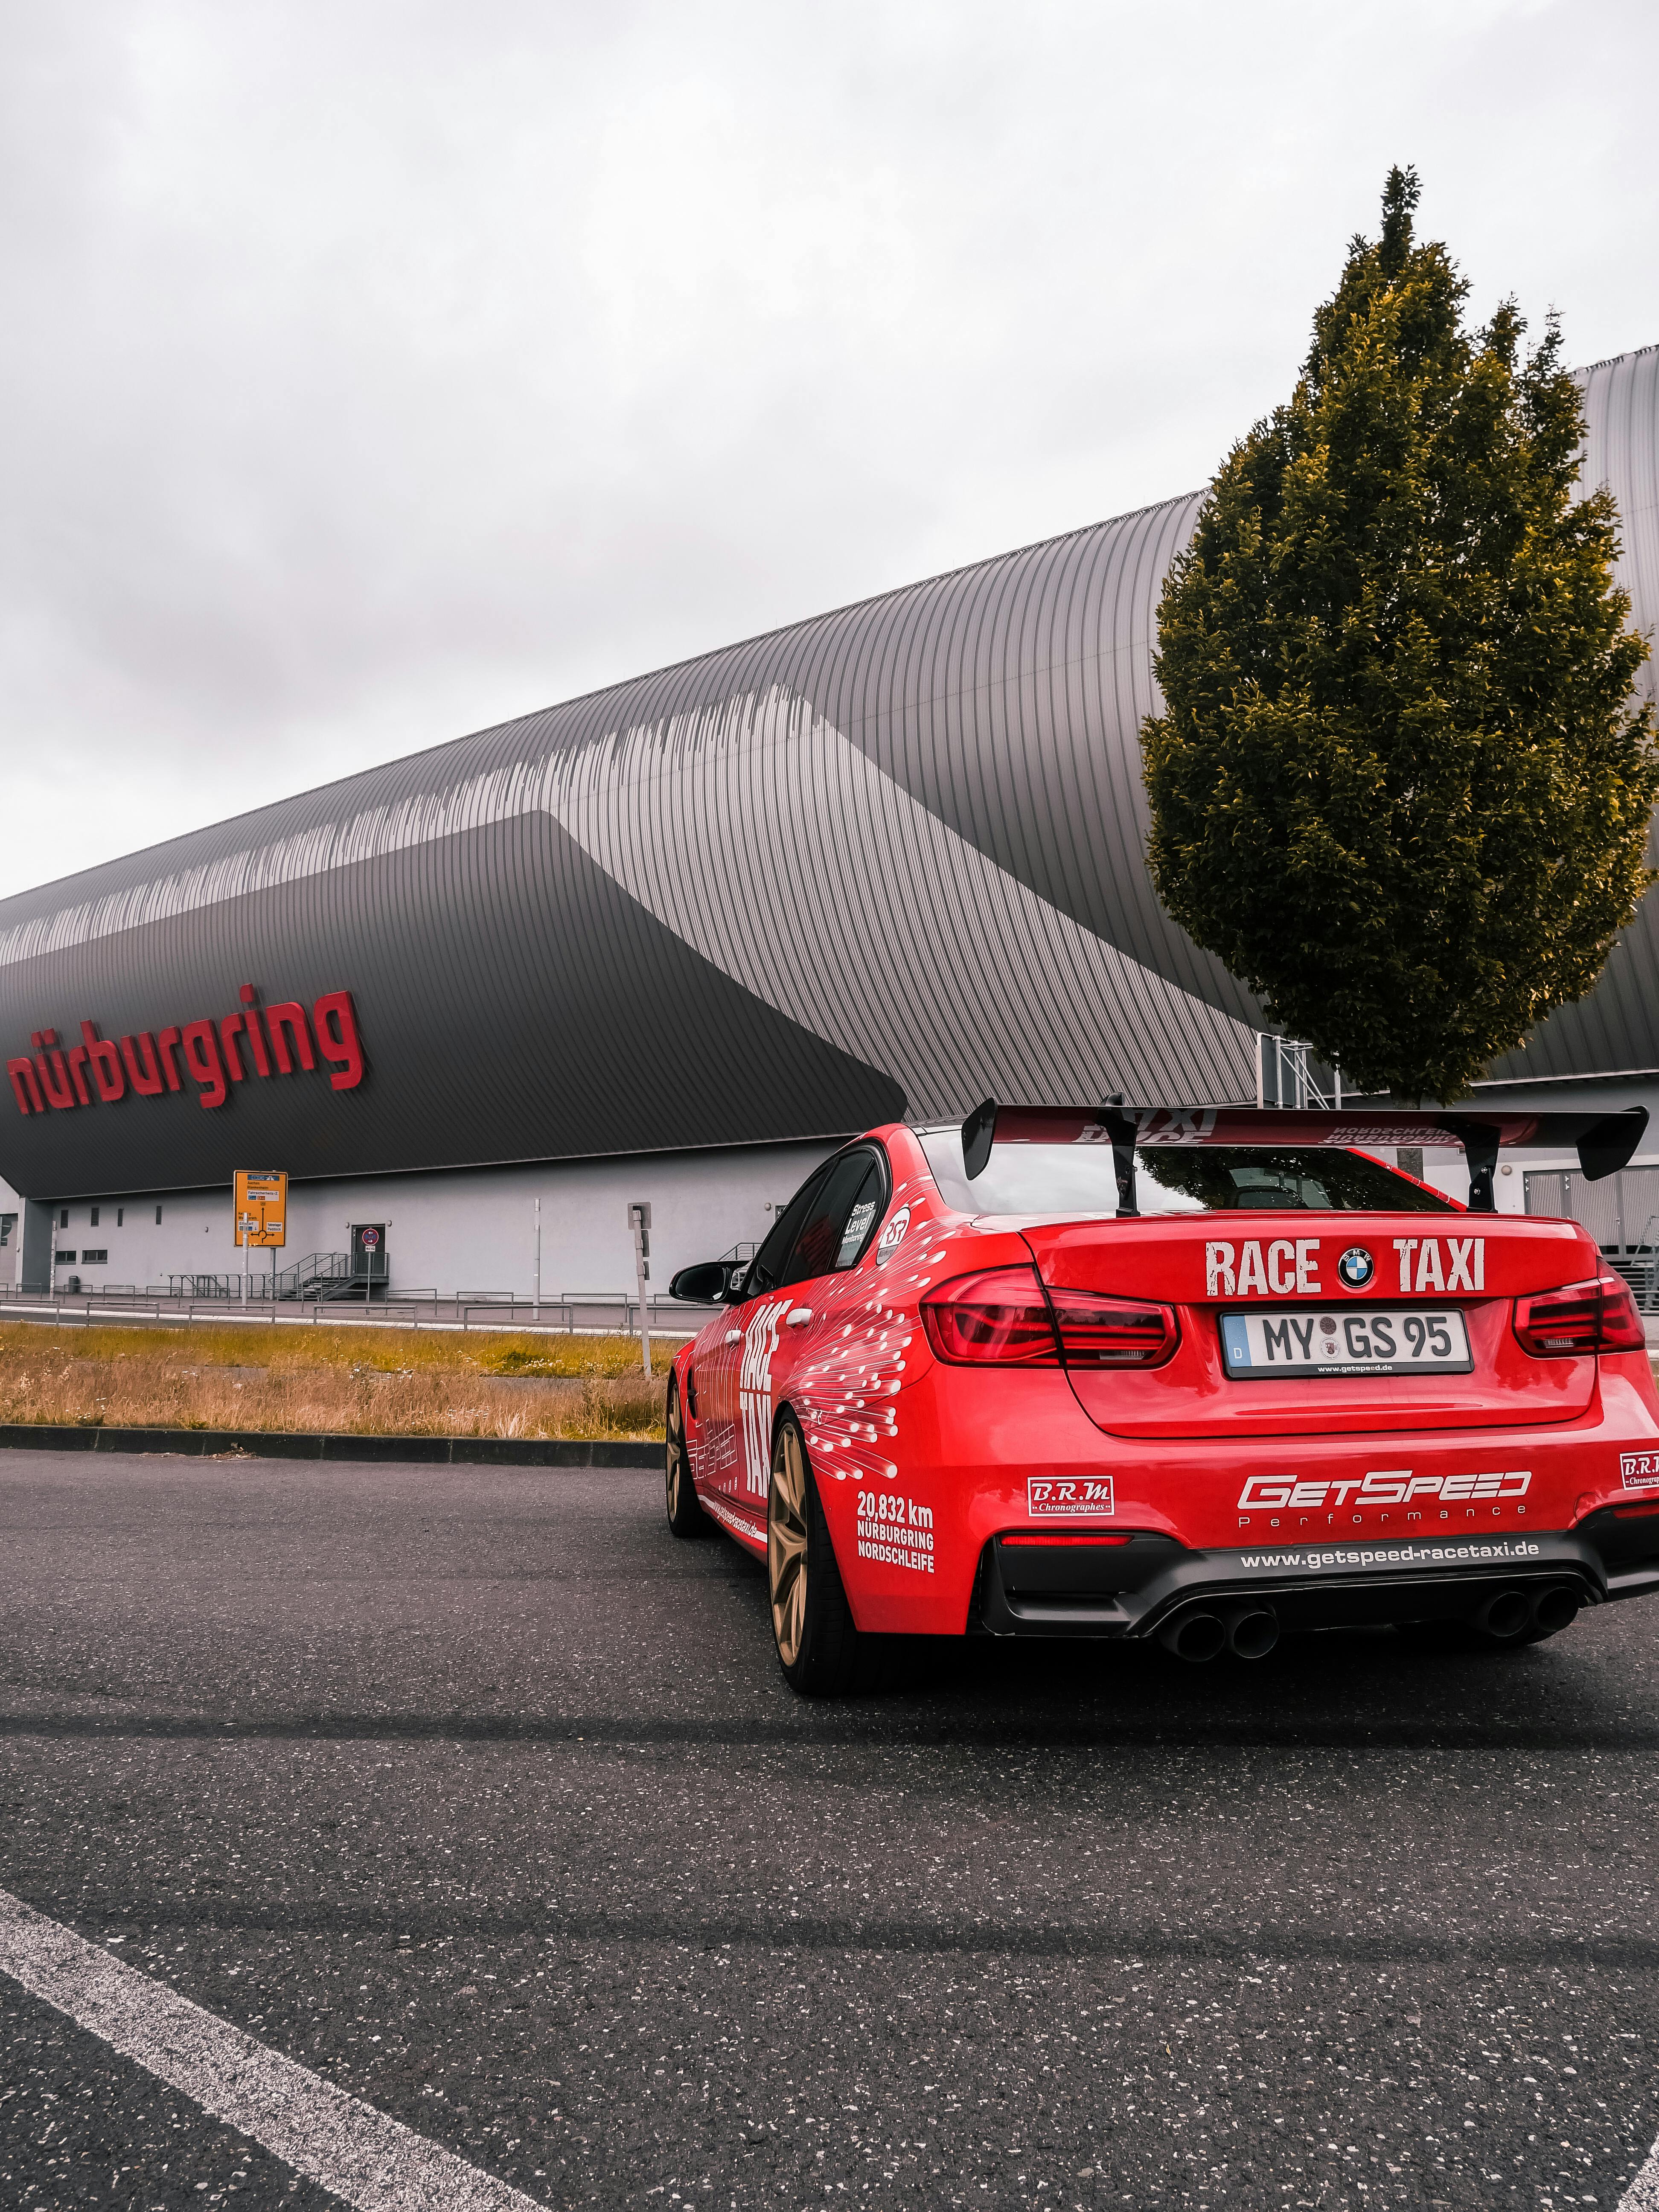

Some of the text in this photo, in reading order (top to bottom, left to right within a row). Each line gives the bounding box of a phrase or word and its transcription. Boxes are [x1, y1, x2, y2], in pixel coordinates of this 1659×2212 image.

[6, 984, 364, 1115] nürburgring
[851, 1201, 876, 1217] Stress
[844, 1212, 872, 1235] Level
[841, 1232, 864, 1245] Monitoring
[1206, 1238, 1484, 1296] RACE TAXI
[739, 1299, 794, 1391] RACE
[1262, 1318, 1314, 1361] MY
[1343, 1316, 1397, 1359] GS
[1403, 1316, 1452, 1357] 95
[1234, 1347, 1243, 1359] D
[1317, 1365, 1393, 1373] www.getspeed.de
[1031, 1482, 1110, 1501] B.R.M
[857, 1491, 933, 1528] 20,832 km
[1039, 1502, 1105, 1513] Chronographes
[1238, 1505, 1525, 1528] Performance
[857, 1517, 934, 1551] NÜRBURGRING
[858, 1540, 934, 1574] NORDSCHLEIFE
[1240, 1541, 1539, 1569] www.getspeed-racetaxi.de
